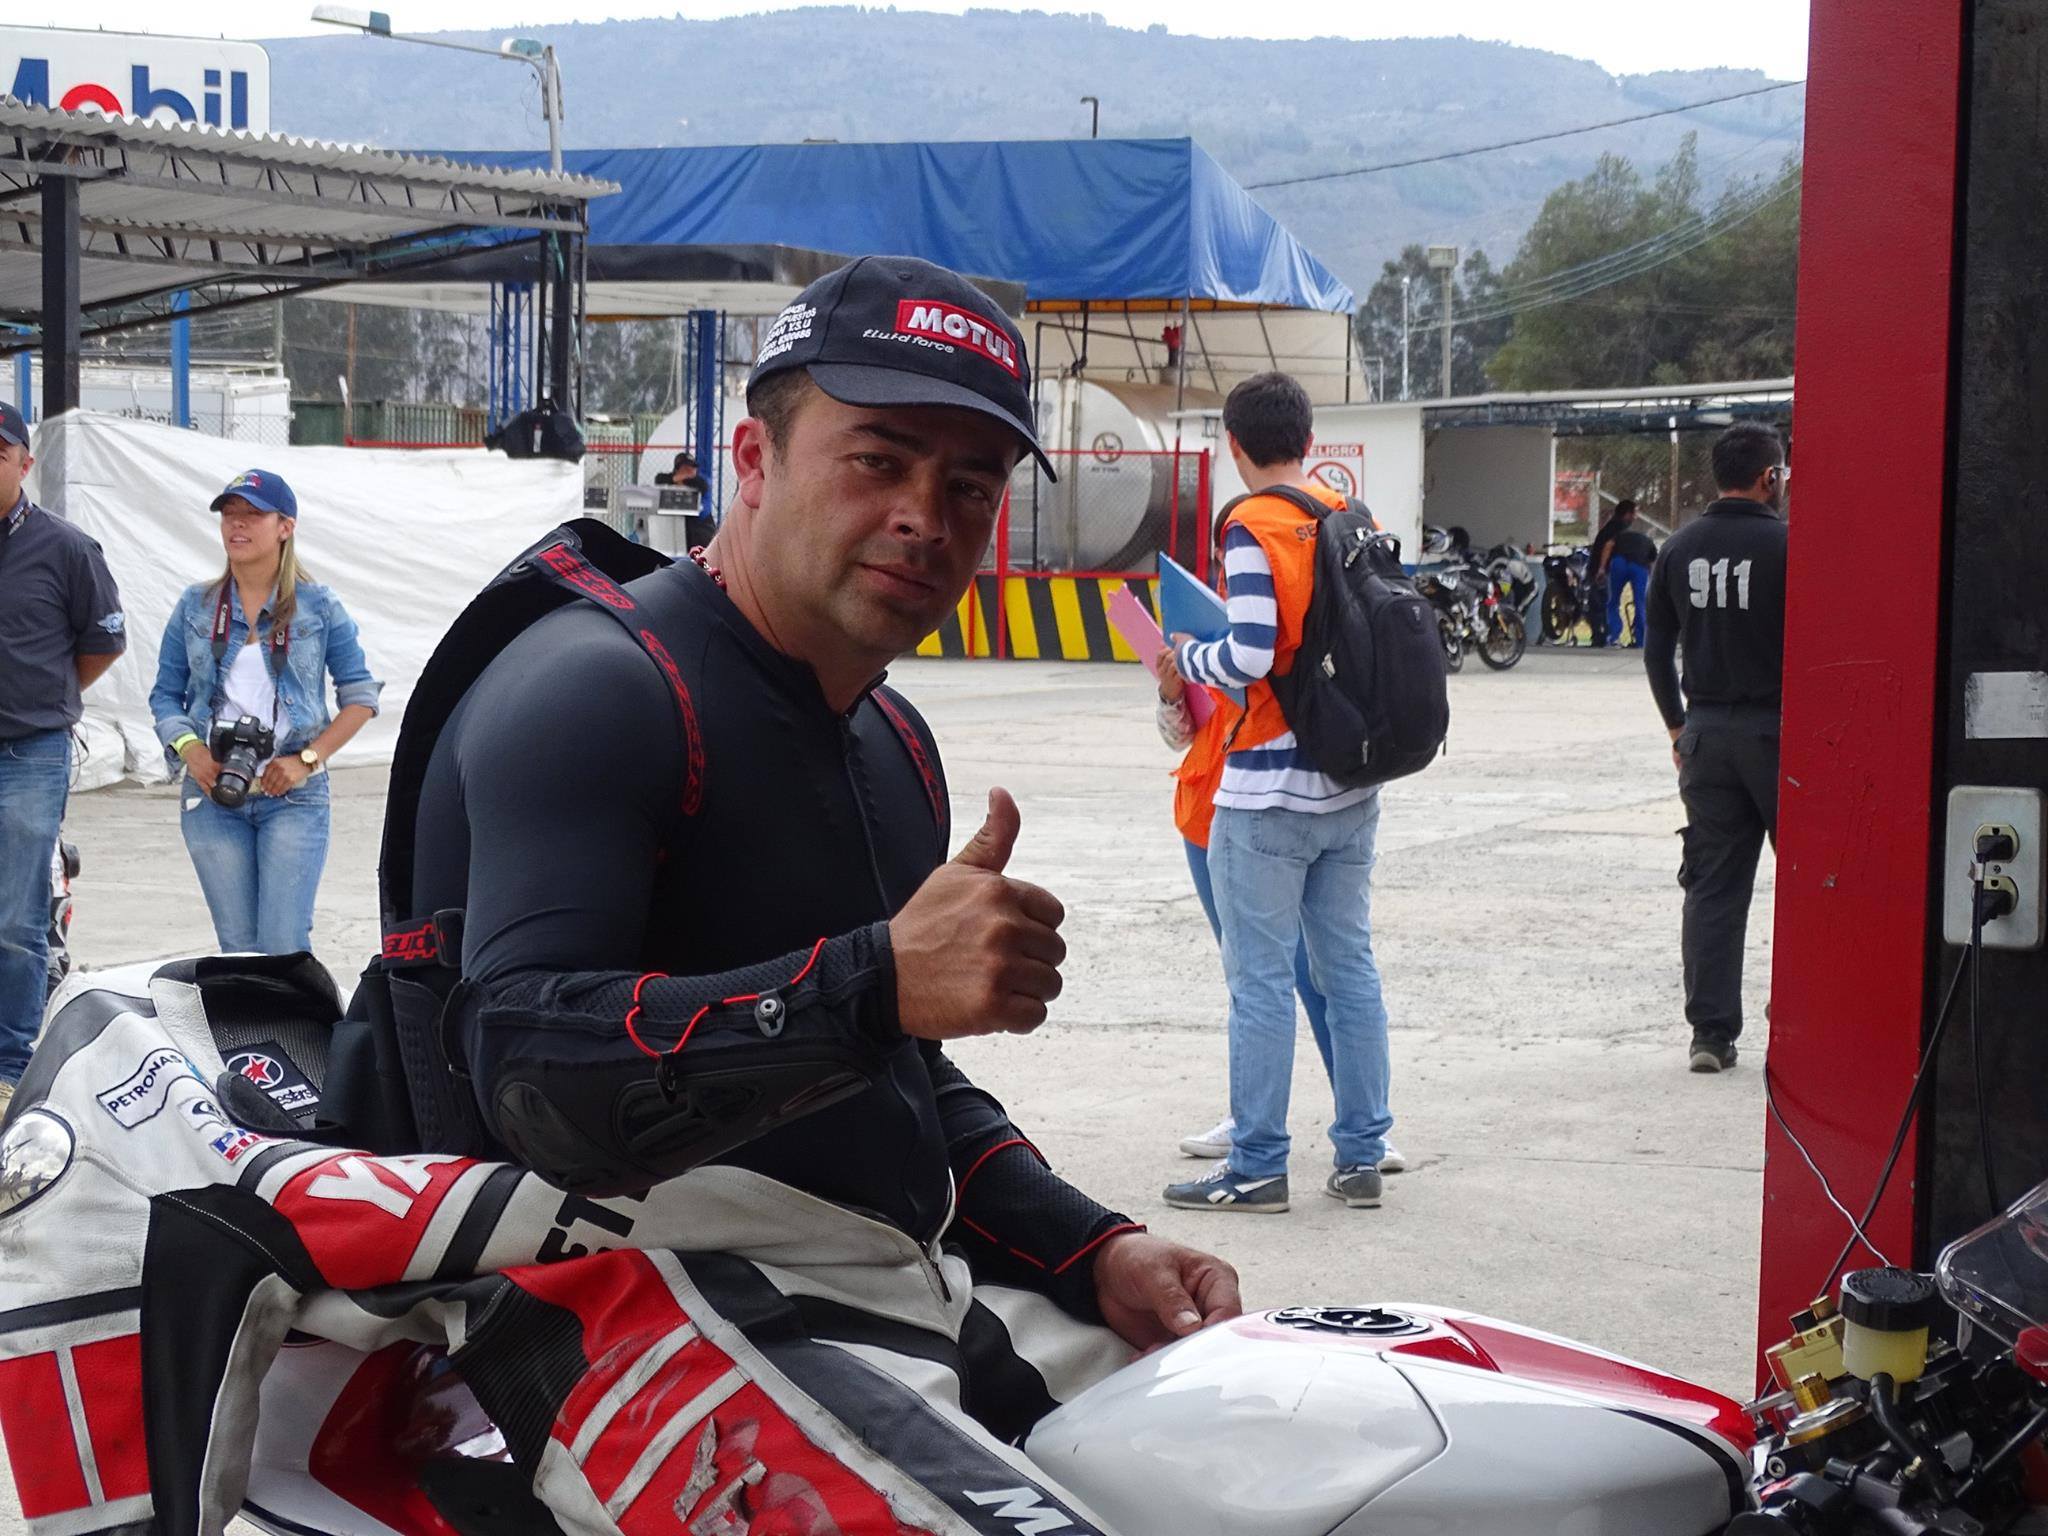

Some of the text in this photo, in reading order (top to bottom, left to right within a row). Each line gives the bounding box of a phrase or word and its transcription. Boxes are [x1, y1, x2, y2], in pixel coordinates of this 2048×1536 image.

[862, 329, 955, 354] fluid force
[907, 306, 1014, 369] MOTUL
[1309, 446, 1359, 457] ELIGRO
[1688, 557, 1752, 610] 911
[107, 1054, 182, 1113] PETRONAS
[306, 1154, 460, 1219] YA
